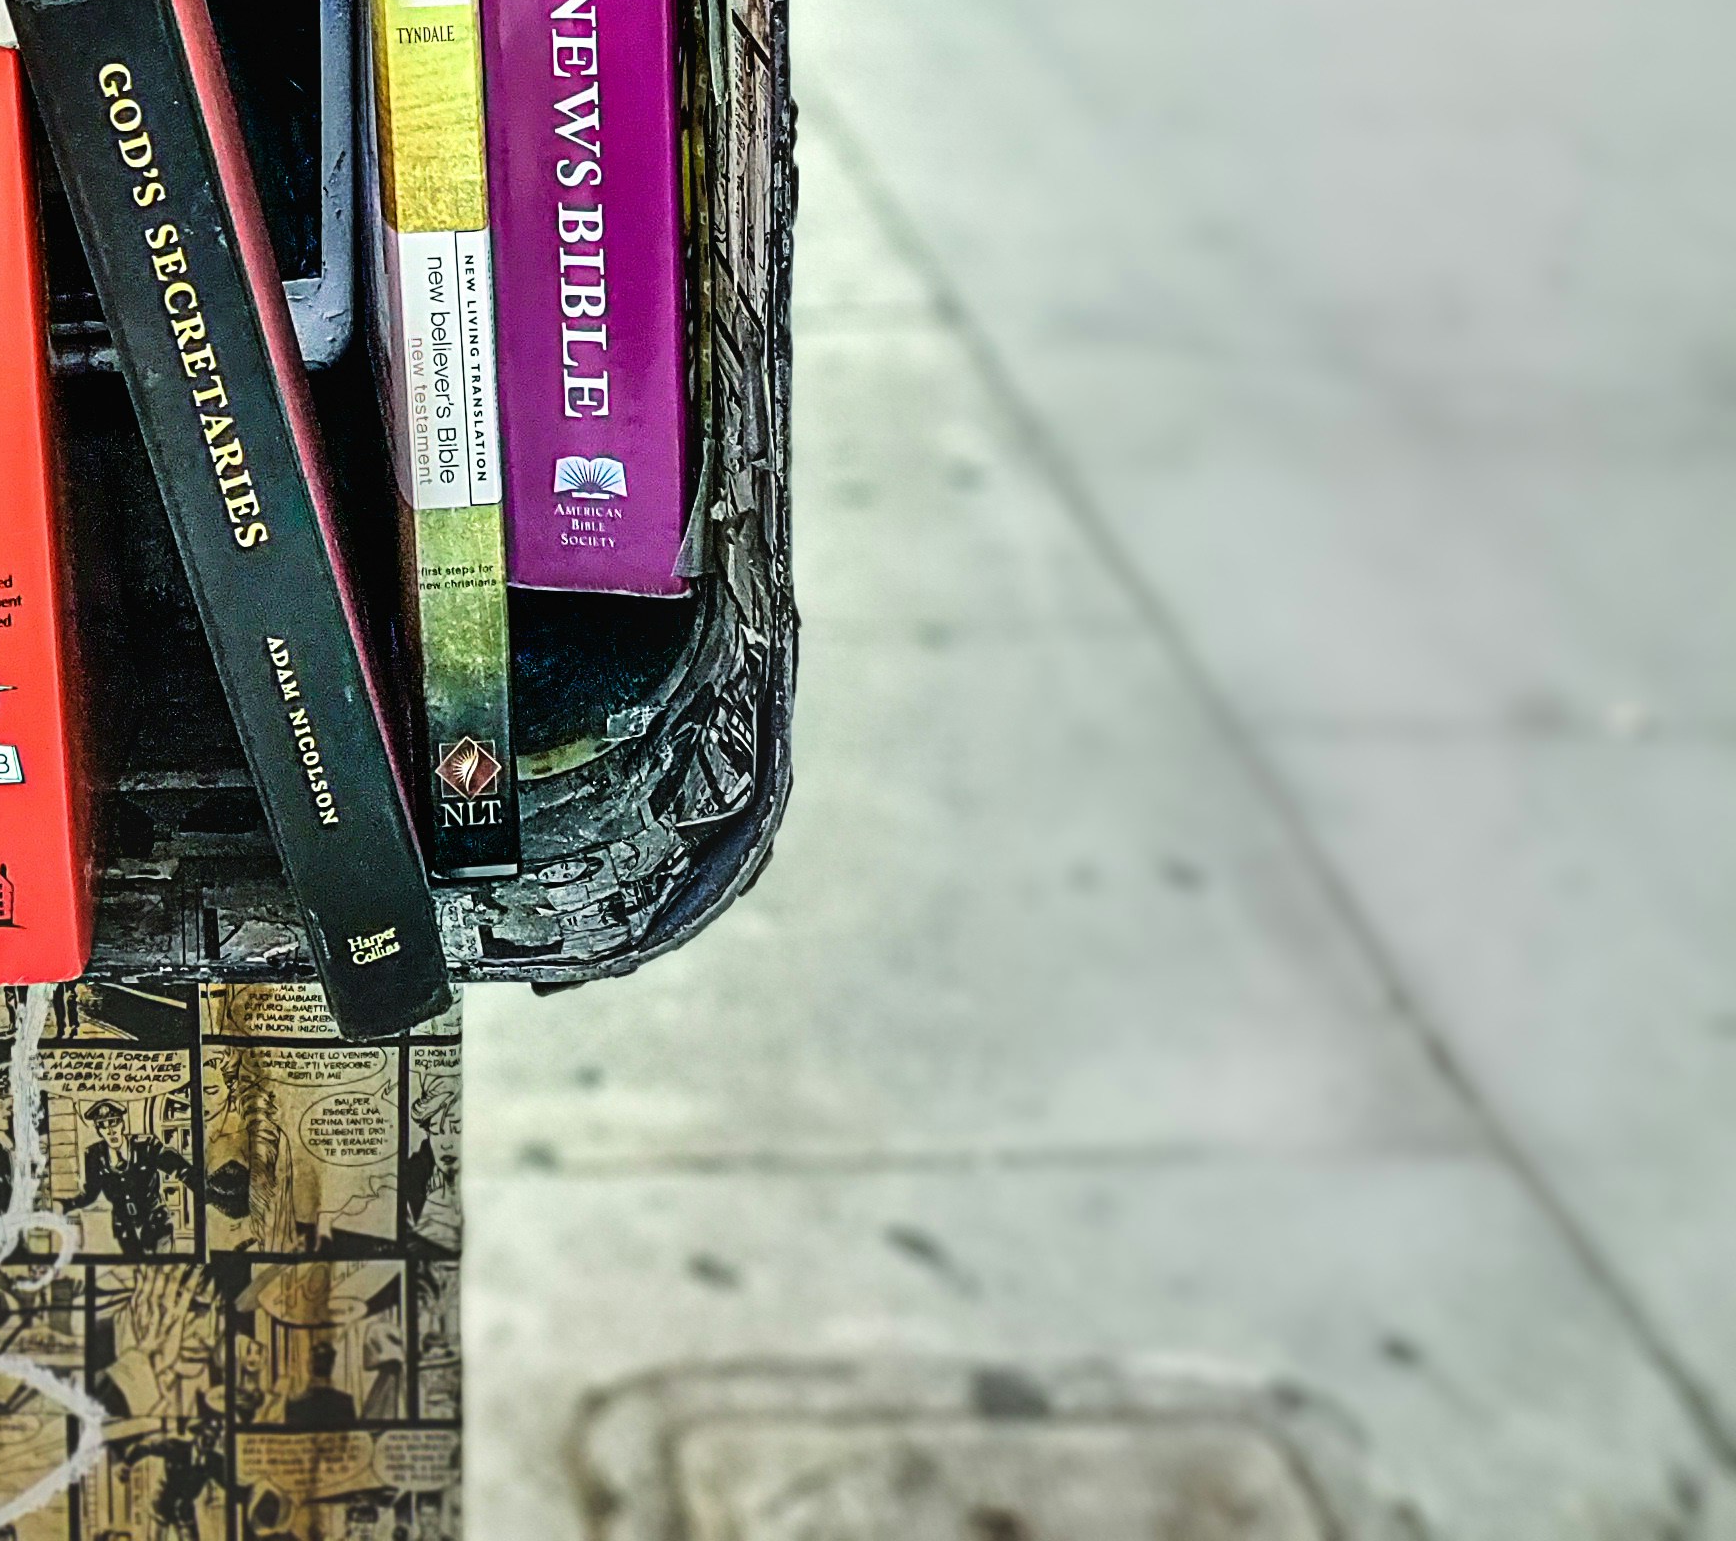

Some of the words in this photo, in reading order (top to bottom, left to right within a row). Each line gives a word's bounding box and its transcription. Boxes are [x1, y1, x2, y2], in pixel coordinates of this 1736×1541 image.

[396, 24, 455, 45] TYNDALE
[426, 256, 445, 303] new
[465, 254, 476, 292] NEW
[98, 62, 166, 207] GOD'S
[145, 222, 270, 549] SECRETARIES
[557, 201, 610, 418] BIBLE
[467, 298, 480, 358] LIVING
[411, 337, 424, 376] new
[430, 311, 453, 420] believer's
[413, 384, 433, 486] testament
[470, 364, 487, 483] TRANSLATION
[438, 427, 459, 484] Bible
[554, 502, 622, 518] AMERICAN
[571, 518, 606, 532] BIBLE
[561, 532, 616, 549] SOCIETY
[419, 580, 441, 590] new
[444, 576, 496, 589] christians
[420, 566, 442, 577] first
[446, 565, 475, 577] steps
[477, 564, 493, 574] for
[266, 635, 301, 701] ADAM
[289, 708, 339, 826] NICOLSON
[440, 800, 501, 827] NLT
[347, 928, 396, 953] Harper
[352, 941, 400, 966] Collins
